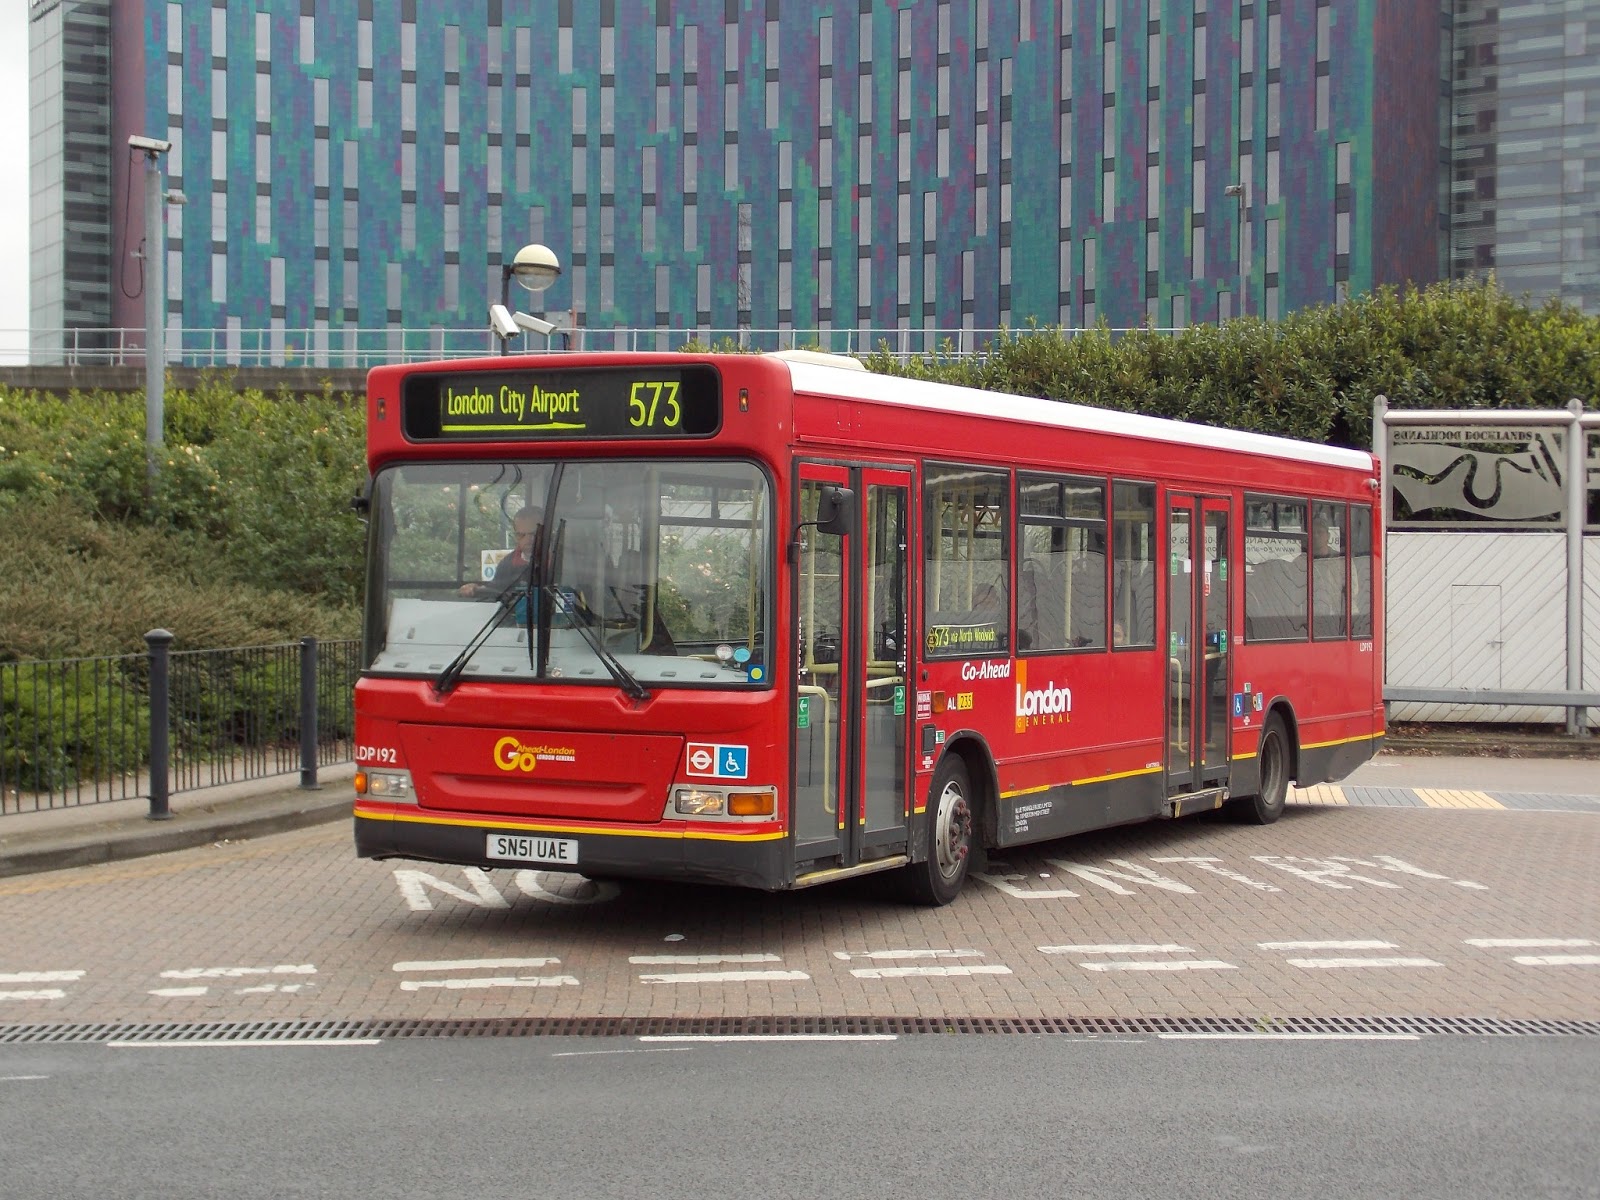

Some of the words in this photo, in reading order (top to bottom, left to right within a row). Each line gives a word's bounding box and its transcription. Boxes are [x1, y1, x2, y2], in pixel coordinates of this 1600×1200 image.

[447, 386, 494, 415] London
[500, 385, 526, 422] City
[530, 385, 580, 419] Airport
[629, 381, 681, 427] 573
[961, 659, 1011, 681] Go-Ahead
[946, 697, 956, 710] AL
[1015, 681, 1072, 717] London
[1017, 713, 1071, 728] GENERAL
[355, 746, 397, 763] LDP192
[493, 736, 536, 772] Go
[497, 837, 533, 857] SN51
[536, 841, 568, 860] UAE
[392, 866, 622, 911] NO
[968, 855, 1489, 899] ENTRY
